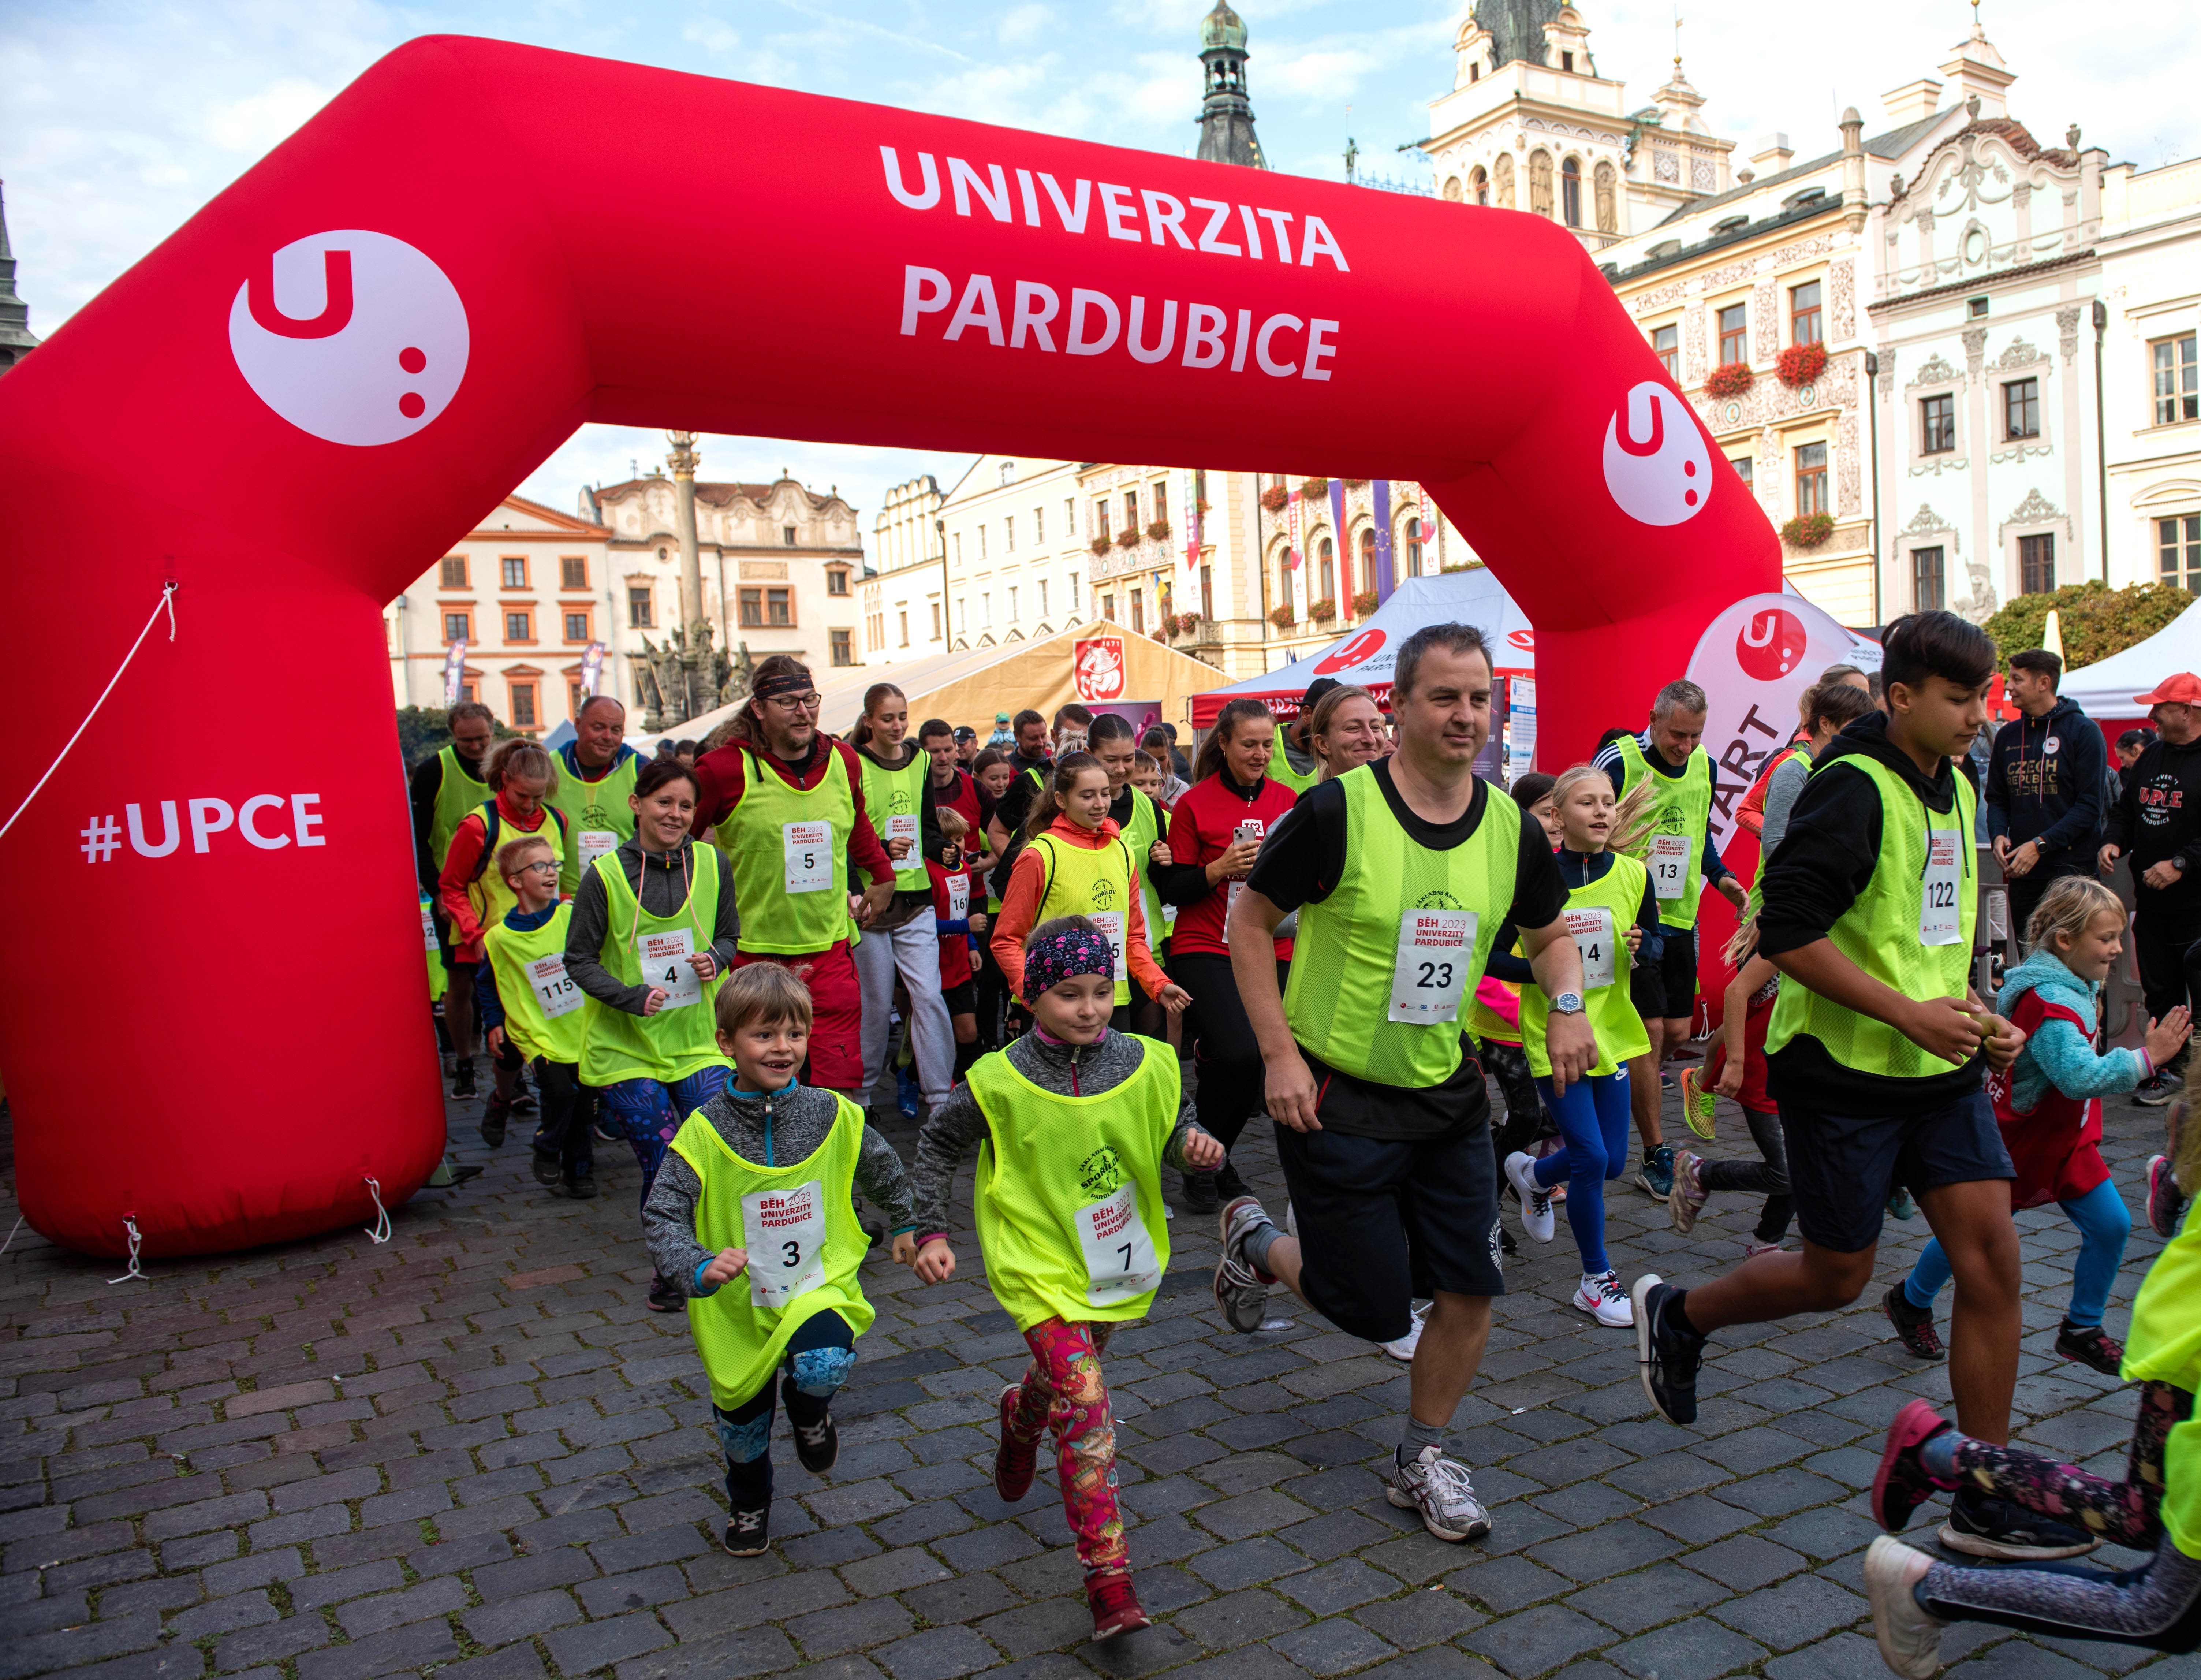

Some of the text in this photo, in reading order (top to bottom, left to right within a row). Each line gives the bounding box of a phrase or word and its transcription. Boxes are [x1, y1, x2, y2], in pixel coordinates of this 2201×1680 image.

[879, 146, 1350, 272] UNIVERZITA
[900, 265, 1339, 381] PARDUBICE
[1707, 704, 1779, 836] ART
[2007, 759, 2057, 775] CZECH
[2139, 787, 2182, 808] UPCE
[2141, 813, 2170, 825] PARDUBICE
[81, 793, 326, 863] #UPCE
[804, 853, 814, 869] 5
[1659, 864, 1677, 879] 13
[1928, 882, 1954, 908] 122
[953, 897, 967, 910] 161
[1417, 916, 1466, 929] BĚH 2023
[1565, 912, 1601, 923] BĚH 2023
[1416, 929, 1465, 938] UNIVERZITY
[1571, 926, 1603, 935] ARDUBICE
[647, 935, 683, 946] BĚH 2023
[648, 942, 683, 952] UNIVERZITY
[1415, 938, 1463, 947] PARDUBICE
[649, 948, 685, 958] PARDUBICE
[538, 966, 565, 979] PARDUBICE
[665, 966, 678, 983] 4
[1417, 962, 1452, 988] 23
[542, 977, 573, 999] 115
[760, 1192, 811, 1210] BĚH 2023
[1092, 1192, 1130, 1223] BĚH 2023
[761, 1202, 812, 1218] UNIVERZITY
[1094, 1202, 1131, 1231] UNIVERZITY
[762, 1211, 812, 1227] PARDUBICE
[1096, 1211, 1132, 1240] PARDUBICE
[782, 1241, 801, 1268] 3
[1118, 1241, 1131, 1271] 7
